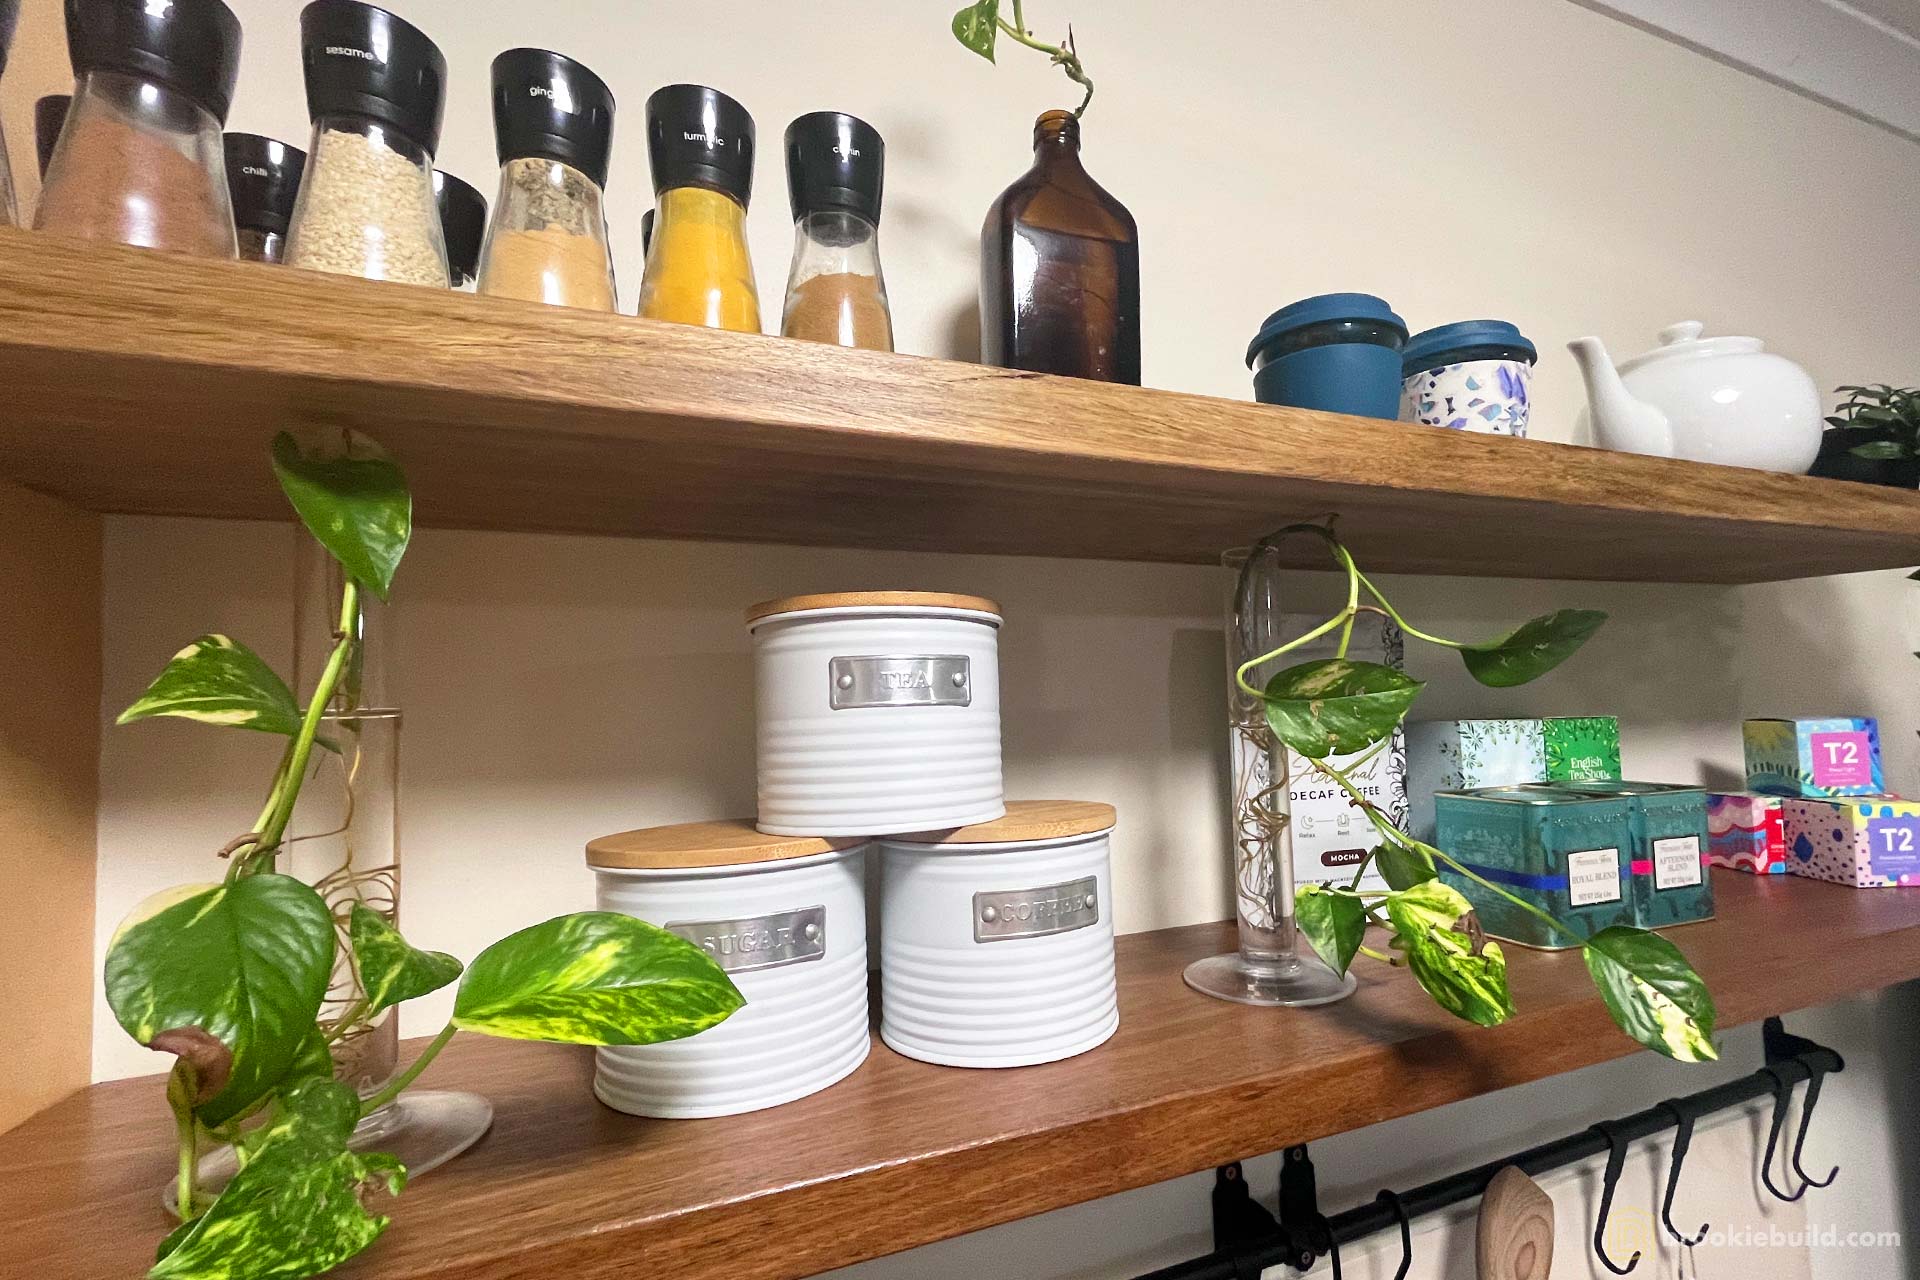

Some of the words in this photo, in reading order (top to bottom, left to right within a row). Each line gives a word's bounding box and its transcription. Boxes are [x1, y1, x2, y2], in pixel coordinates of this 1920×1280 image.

[325, 46, 374, 60] sesame
[529, 86, 560, 101] ging
[683, 131, 725, 146] turmic
[832, 146, 861, 157] cin
[242, 166, 268, 177] chilli
[880, 670, 931, 690] TEA
[1823, 741, 1859, 765] T2
[1570, 755, 1603, 771] English
[1568, 770, 1585, 780] Tea
[1585, 768, 1608, 780] Shop
[1290, 789, 1335, 801] DECAF
[1340, 785, 1381, 798] CFFEE
[1879, 828, 1914, 852] T2
[1330, 853, 1360, 862] MOCHA
[702, 927, 796, 955] SUGAR
